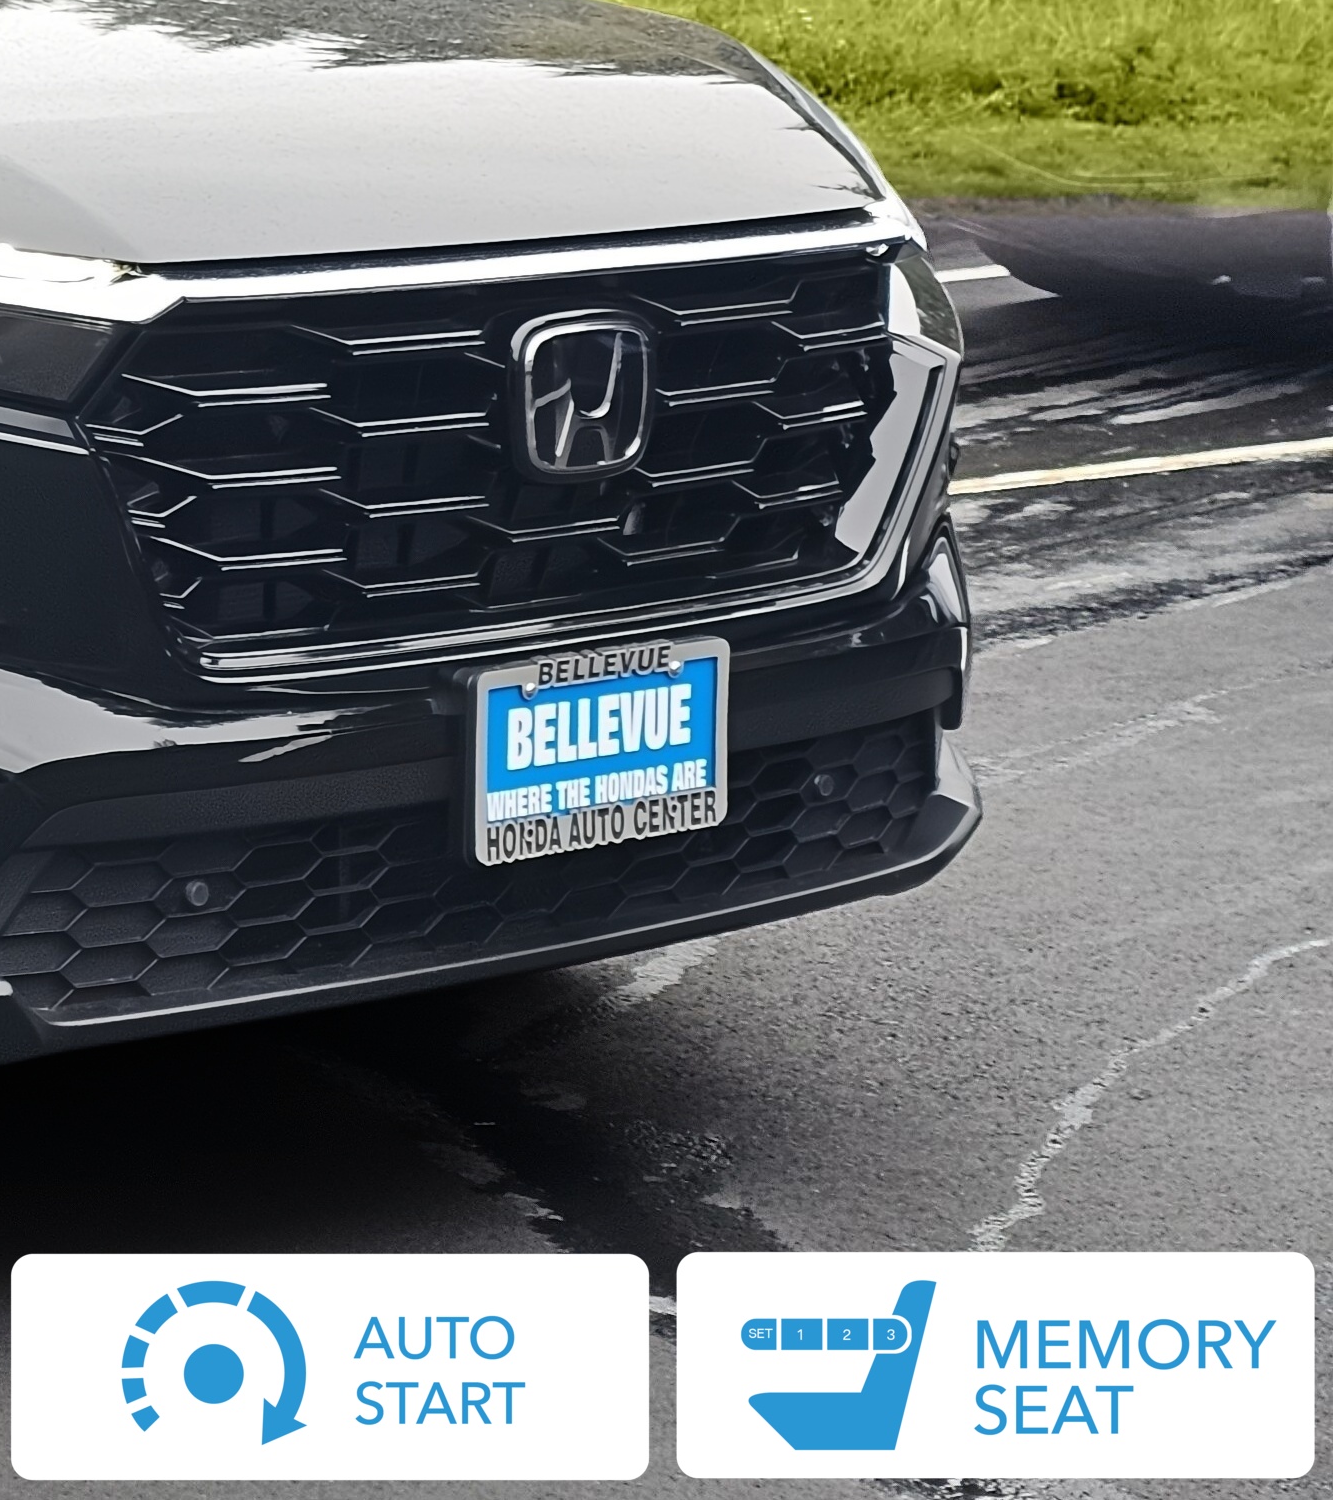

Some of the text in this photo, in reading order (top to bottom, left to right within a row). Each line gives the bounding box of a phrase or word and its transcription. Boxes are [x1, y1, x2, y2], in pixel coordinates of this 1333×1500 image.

[538, 646, 671, 685] BELLEVUE
[507, 683, 692, 770] BELLEVUE
[487, 758, 707, 822] WHERE THE HONDAS ARE
[487, 790, 717, 862] HONDA AUTO CENTER
